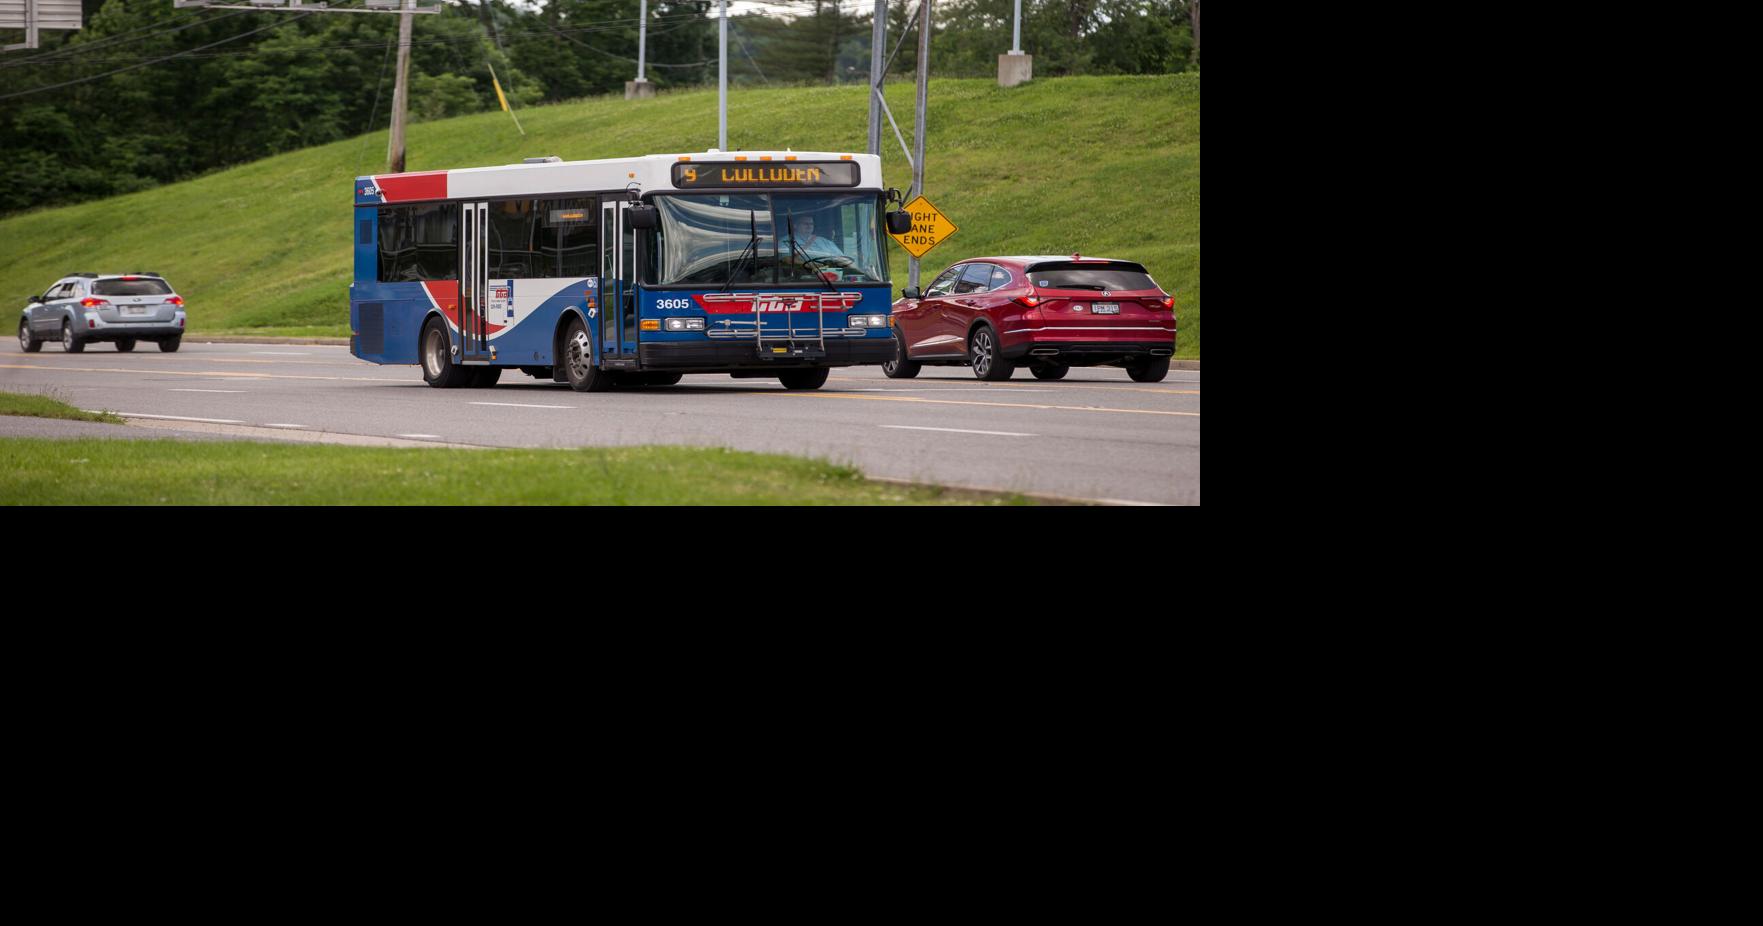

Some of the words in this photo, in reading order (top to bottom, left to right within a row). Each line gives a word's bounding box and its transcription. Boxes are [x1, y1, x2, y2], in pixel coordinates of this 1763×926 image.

[684, 168, 697, 182] 9
[911, 212, 938, 222] IGHT
[911, 224, 935, 234] ANE
[903, 235, 936, 246] ENDS
[656, 299, 690, 309] 3605
